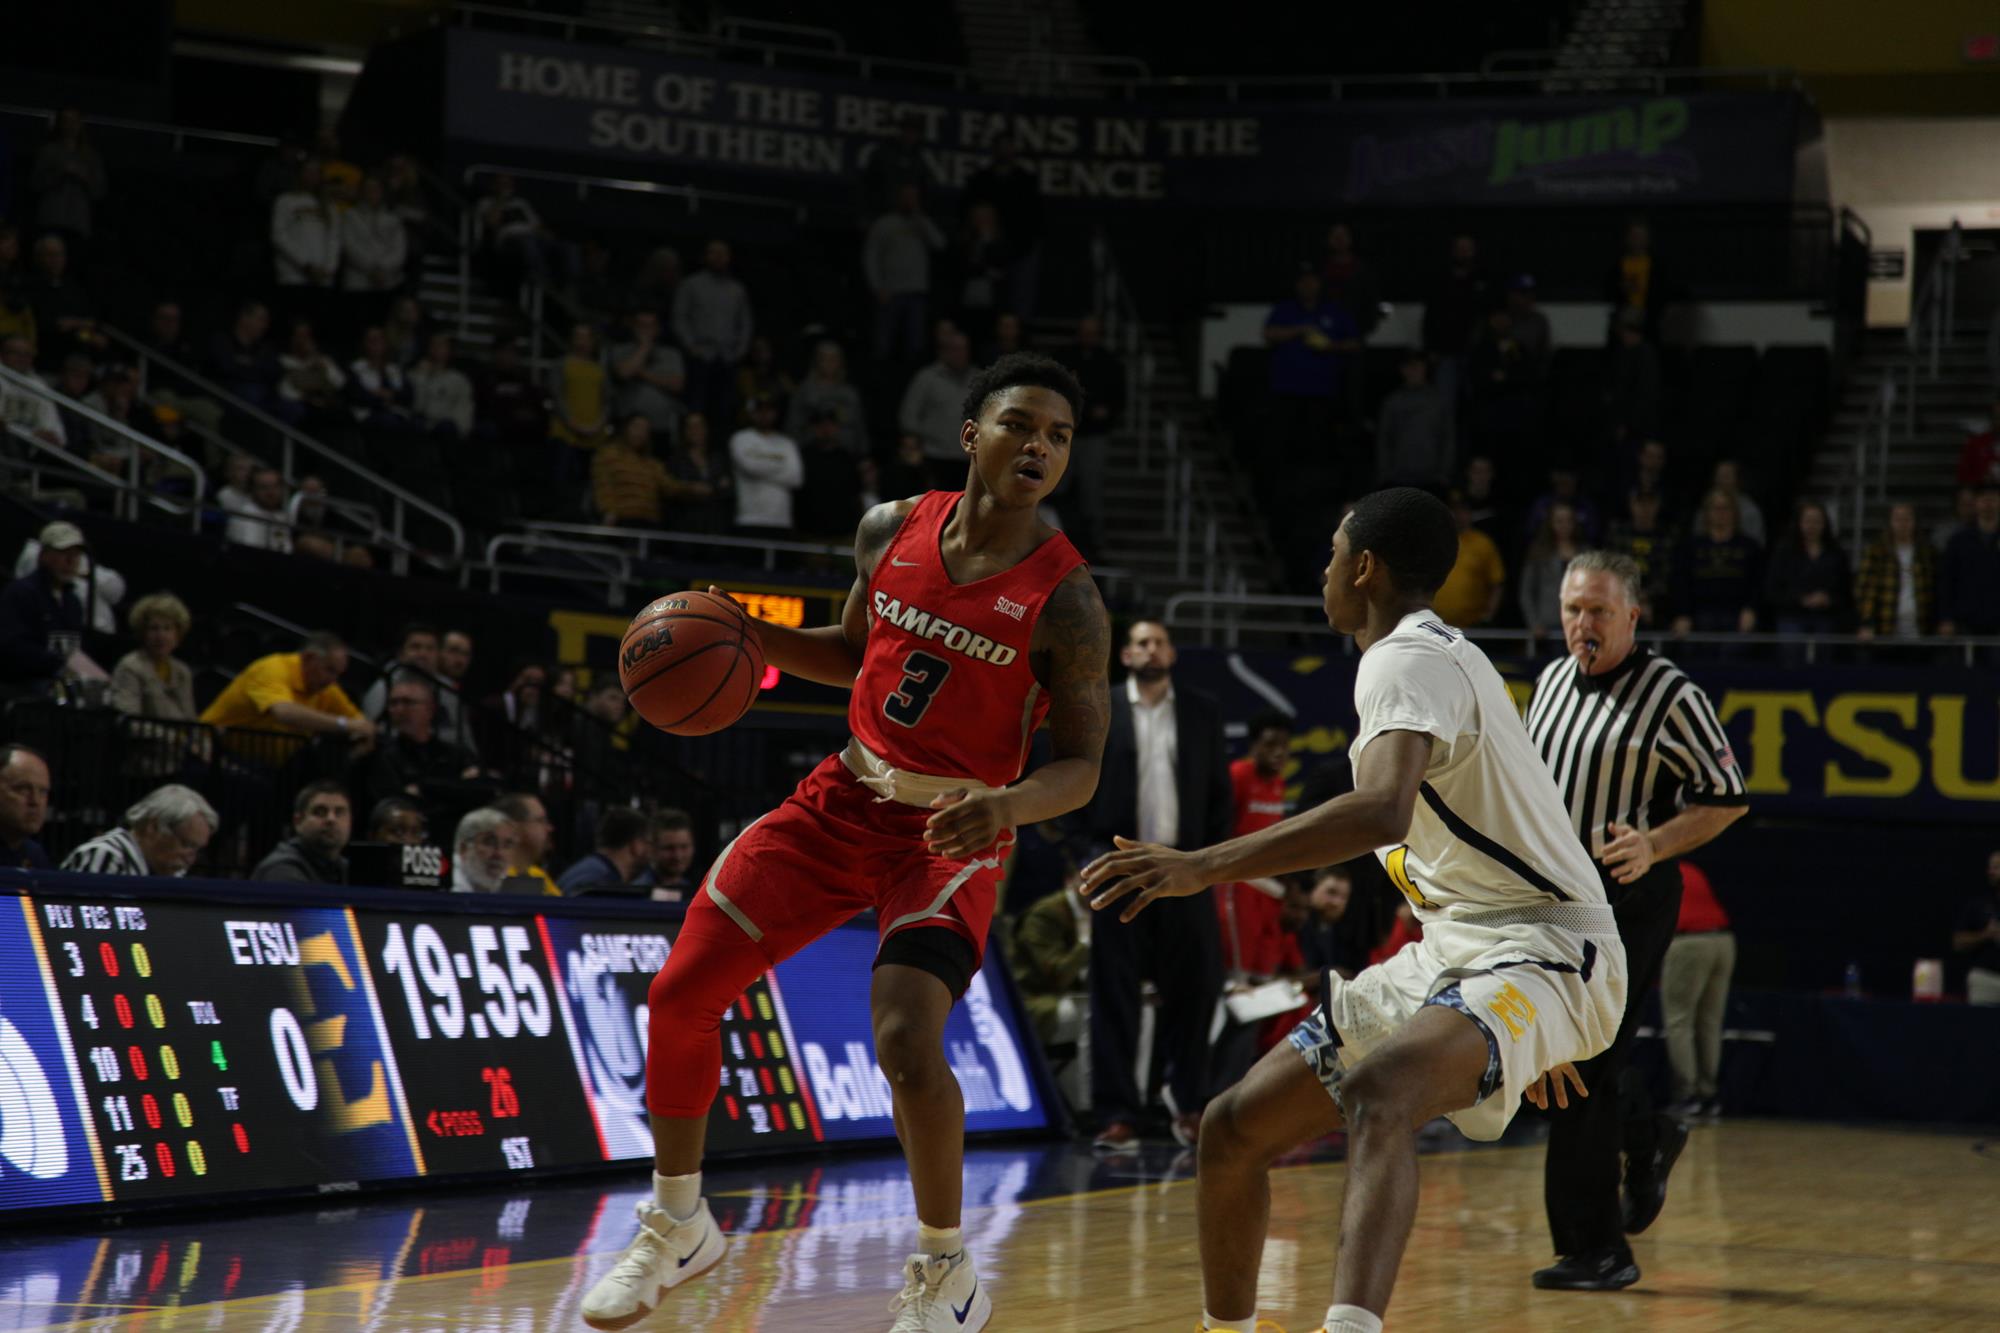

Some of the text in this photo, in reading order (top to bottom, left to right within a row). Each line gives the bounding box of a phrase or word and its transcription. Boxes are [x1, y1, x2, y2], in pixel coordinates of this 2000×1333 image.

[500, 51, 640, 106] HOME
[652, 72, 716, 114] OF
[727, 80, 822, 129] THE
[1093, 117, 1149, 155] IN
[1160, 117, 1261, 157] THE
[589, 109, 845, 174] SOUTHERN
[993, 595, 1029, 621] SOCON
[874, 590, 1018, 666] SAMFORD
[622, 627, 673, 672] NCAA
[883, 649, 952, 729] 3
[1718, 688, 2000, 802] TSU
[401, 844, 441, 876] POSS
[44, 904, 147, 931] PLY FLS PTS
[62, 942, 153, 977] 3 0 0
[224, 921, 301, 966] ETSU
[581, 933, 672, 972] SAMFORD
[382, 922, 552, 1039] 19:55
[81, 994, 166, 1030] 4 0 0
[757, 991, 774, 1021] 0
[210, 1040, 228, 1071] 4
[269, 1007, 318, 1111] 0
[748, 1030, 765, 1060] 0
[767, 1029, 785, 1059] 0
[89, 1045, 181, 1082] 10 0 0
[758, 1066, 776, 1096] 0
[778, 1065, 796, 1095] 0
[217, 1087, 240, 1111] TF
[481, 1066, 521, 1118] 26
[724, 1094, 741, 1121] 0
[103, 1092, 194, 1132] 11 0 0
[440, 1110, 485, 1137] POSS
[770, 1102, 788, 1132] 0
[789, 1101, 807, 1131] 0
[231, 1122, 251, 1154] 0
[500, 1136, 535, 1169] 1ST
[114, 1140, 208, 1181] 25 0 0
